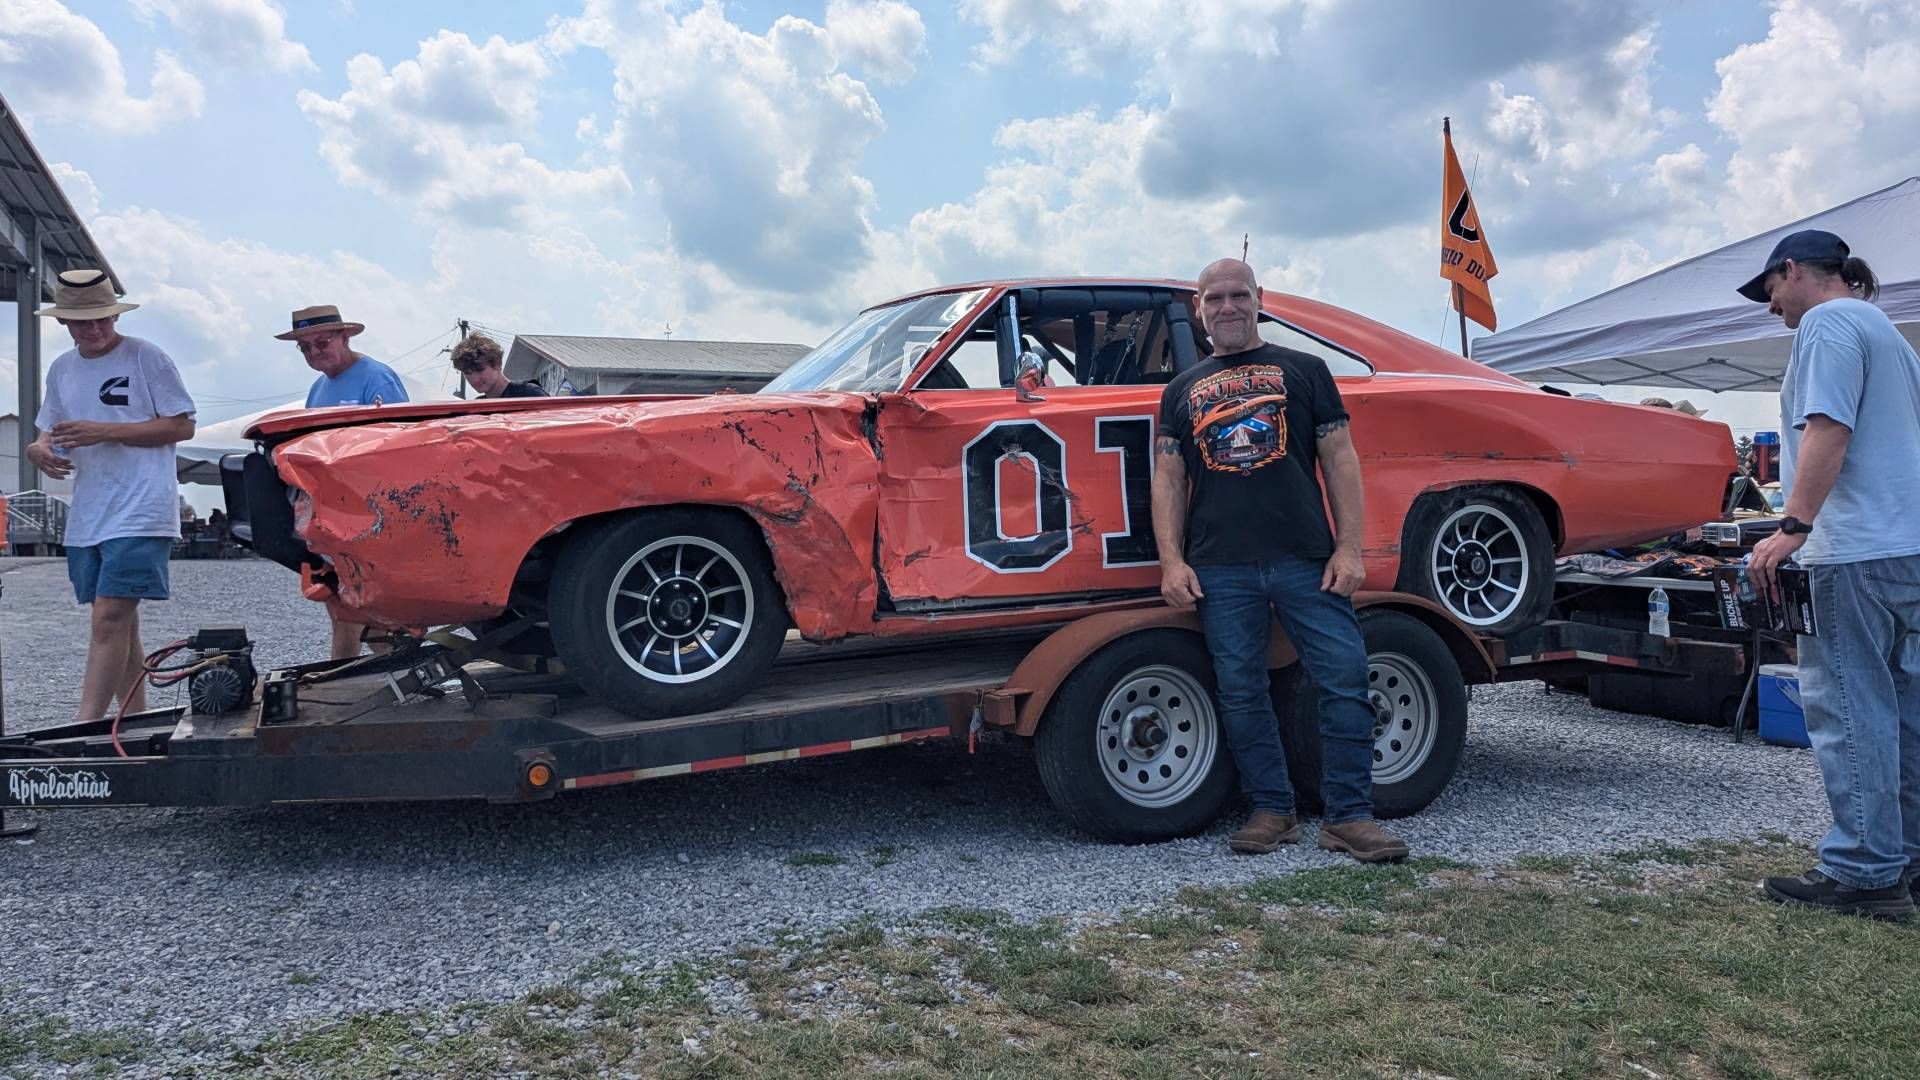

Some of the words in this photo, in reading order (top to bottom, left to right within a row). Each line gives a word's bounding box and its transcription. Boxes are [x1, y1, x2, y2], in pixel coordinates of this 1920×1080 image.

[1465, 259, 1487, 283] DU
[1188, 375, 1287, 418] DUKES
[962, 414, 1161, 574] 01
[1720, 580, 1730, 592] UP
[1723, 593, 1738, 628] BUCKLE
[9, 772, 112, 805] Appalachian
